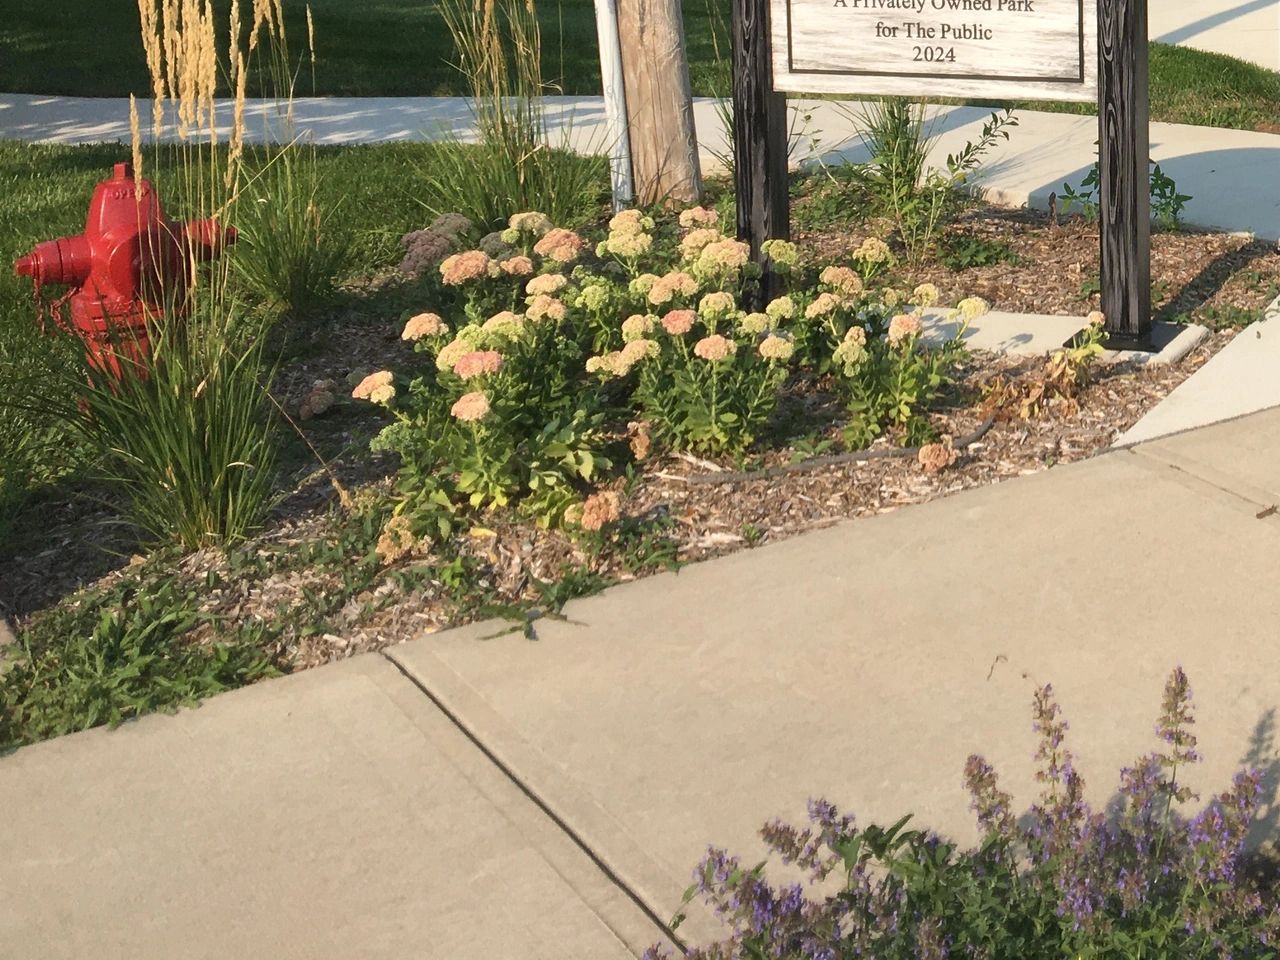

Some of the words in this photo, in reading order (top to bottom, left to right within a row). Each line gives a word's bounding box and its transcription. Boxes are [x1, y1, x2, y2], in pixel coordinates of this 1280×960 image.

[875, 21, 900, 38] for
[902, 22, 936, 39] The
[940, 23, 993, 41] Public
[912, 45, 956, 63] 2024
